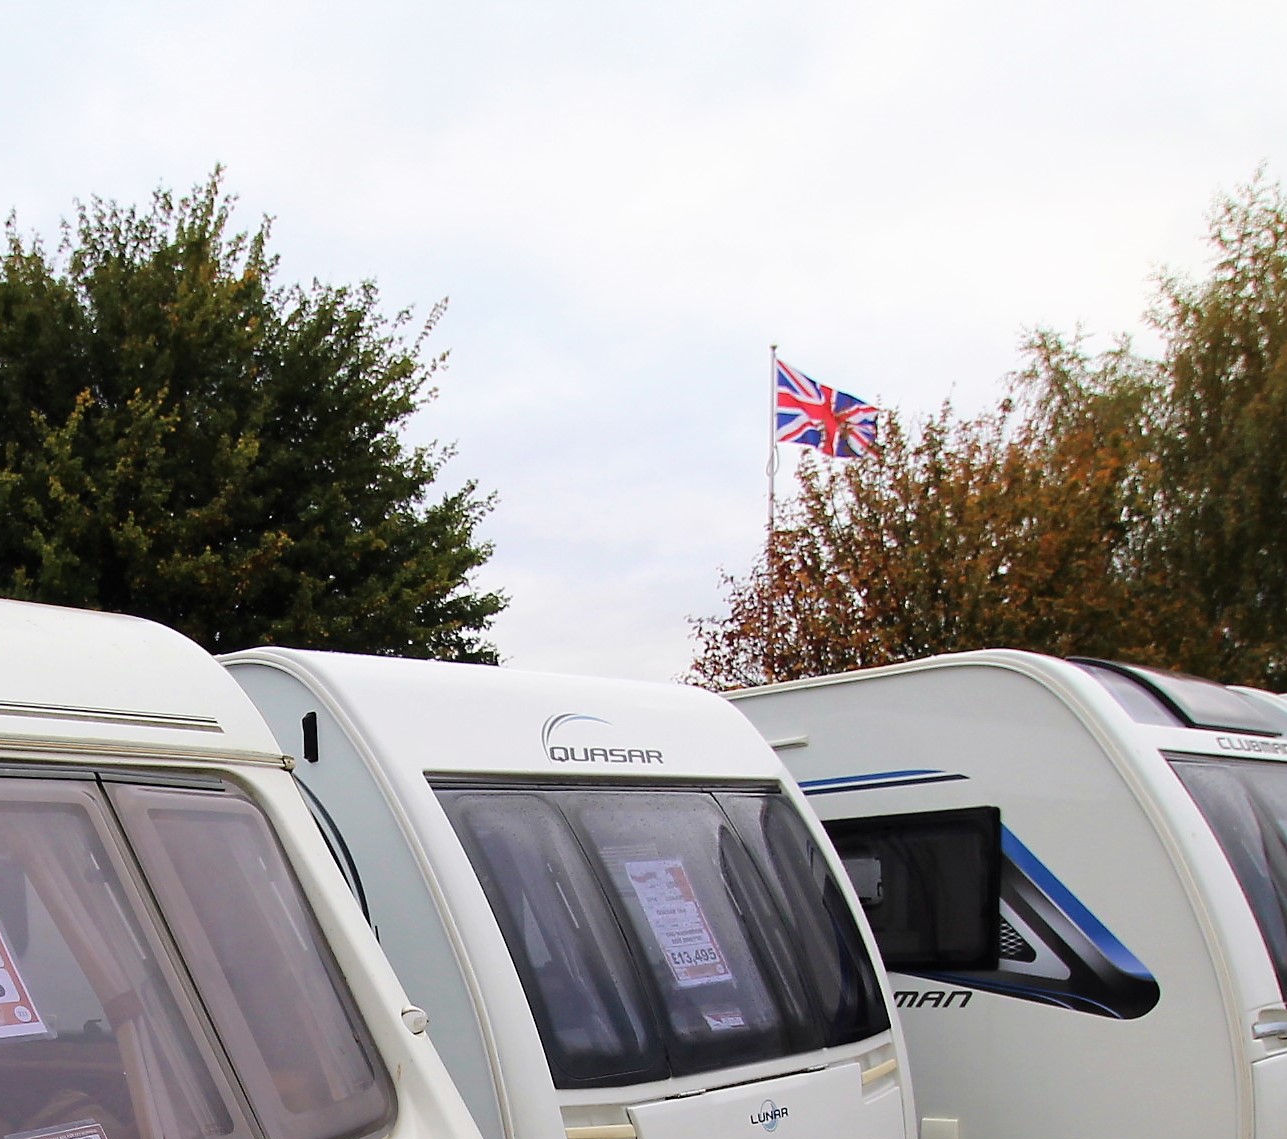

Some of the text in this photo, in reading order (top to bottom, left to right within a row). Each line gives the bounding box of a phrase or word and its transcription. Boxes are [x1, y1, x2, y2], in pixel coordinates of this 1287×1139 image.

[549, 746, 664, 764] QUASAR
[671, 947, 717, 966] £13,495
[750, 1107, 789, 1124] LUNAR
